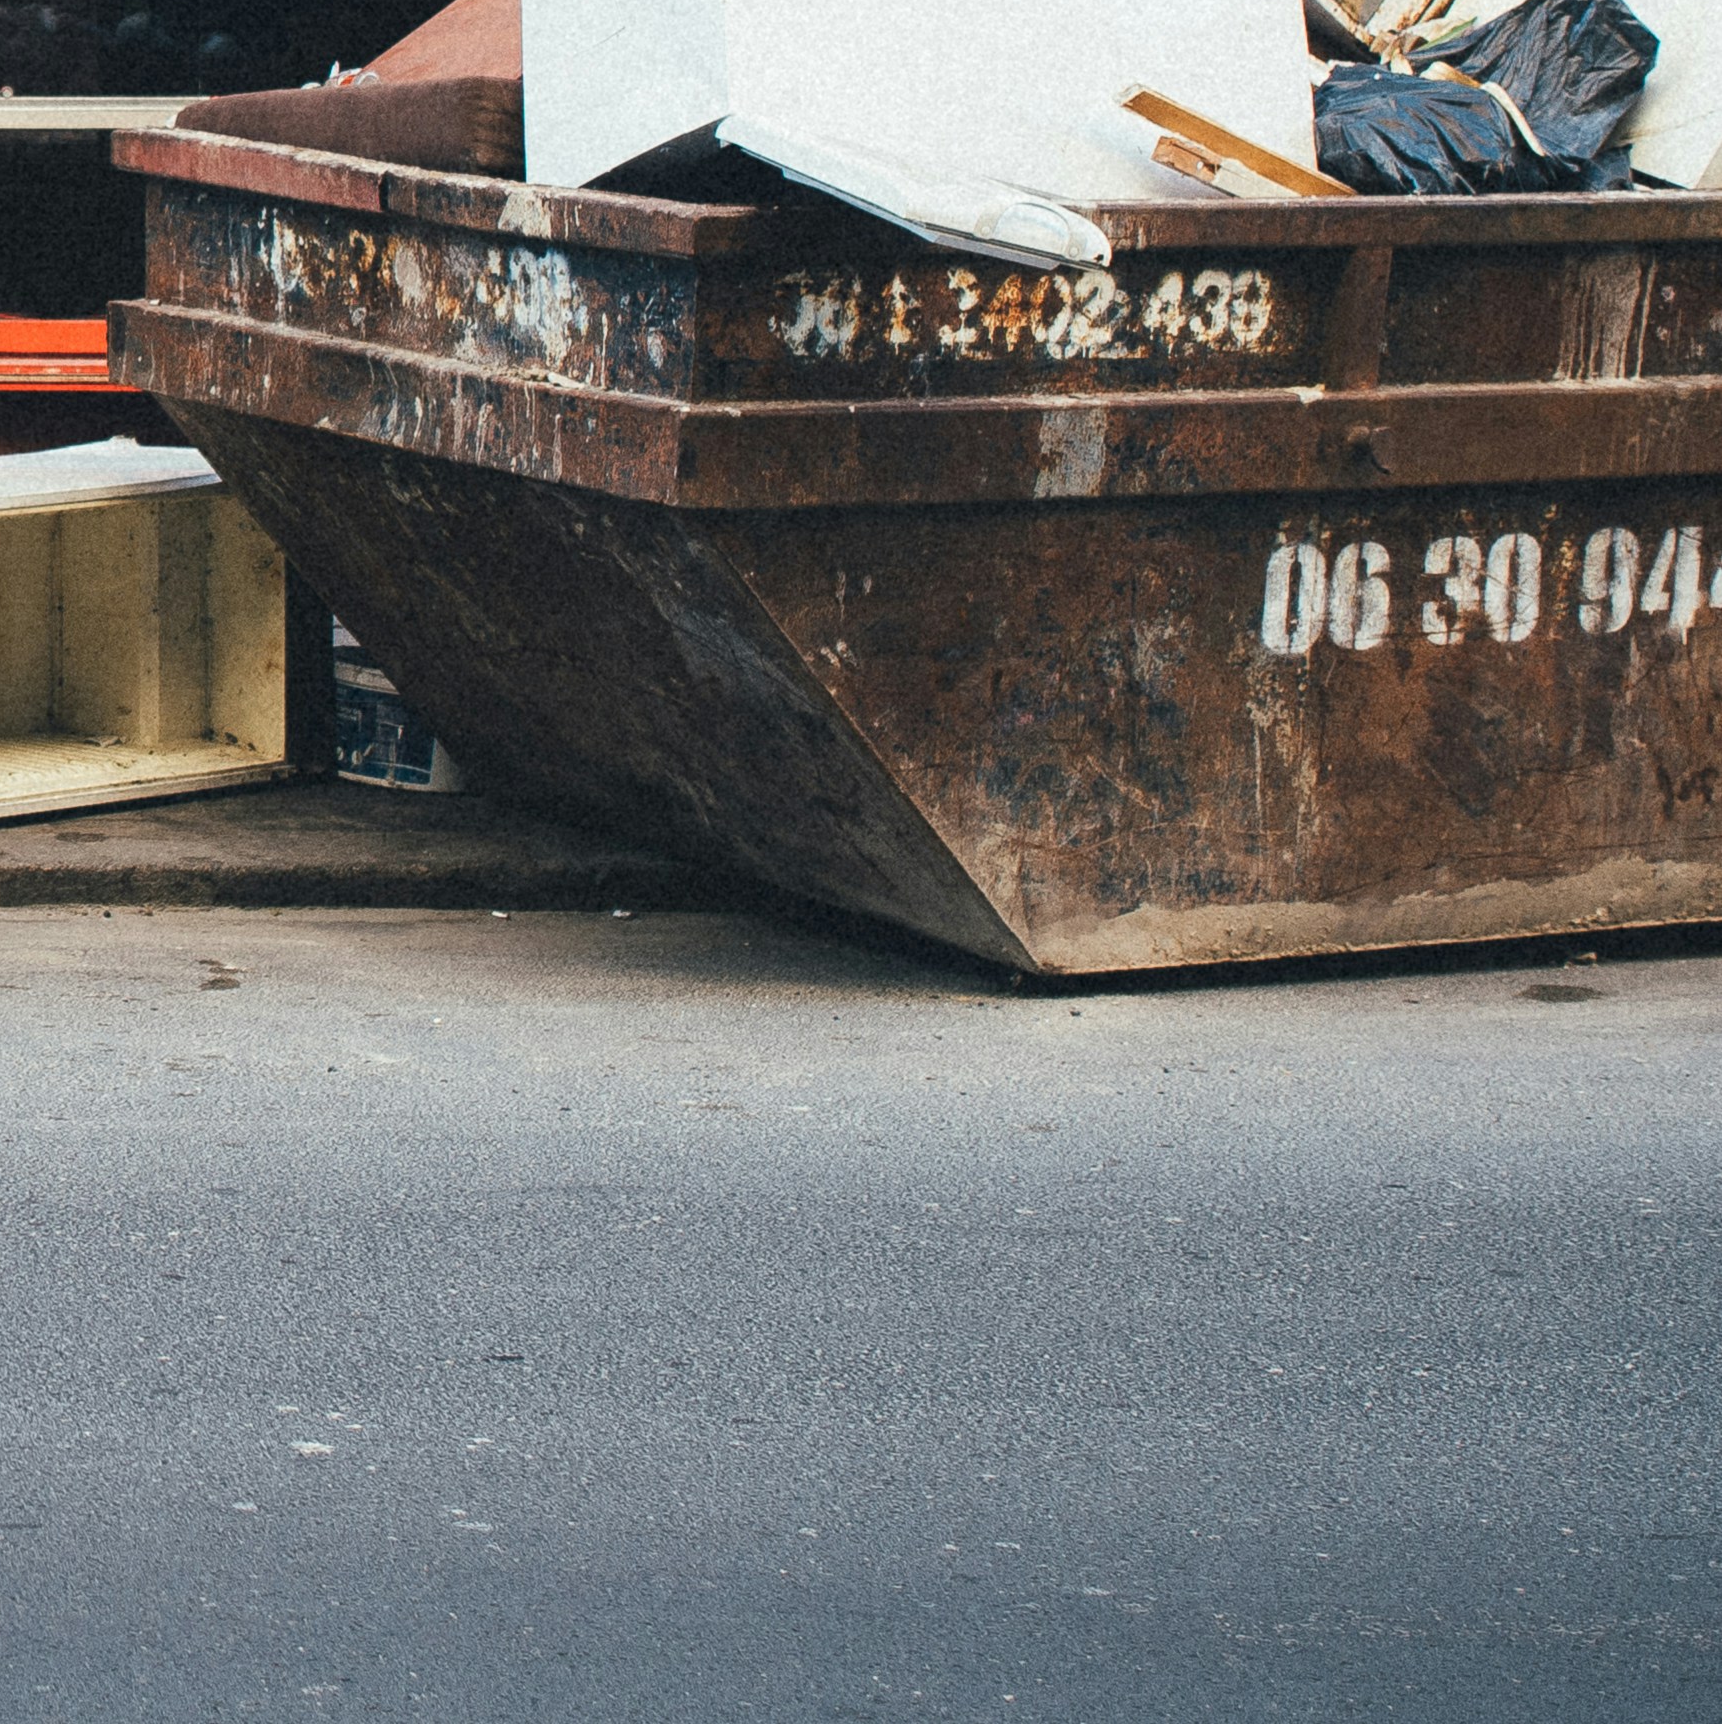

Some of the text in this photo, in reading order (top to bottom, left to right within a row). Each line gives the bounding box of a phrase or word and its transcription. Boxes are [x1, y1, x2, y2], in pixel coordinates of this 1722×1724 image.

[1261, 526, 1722, 655] 06 30 94
